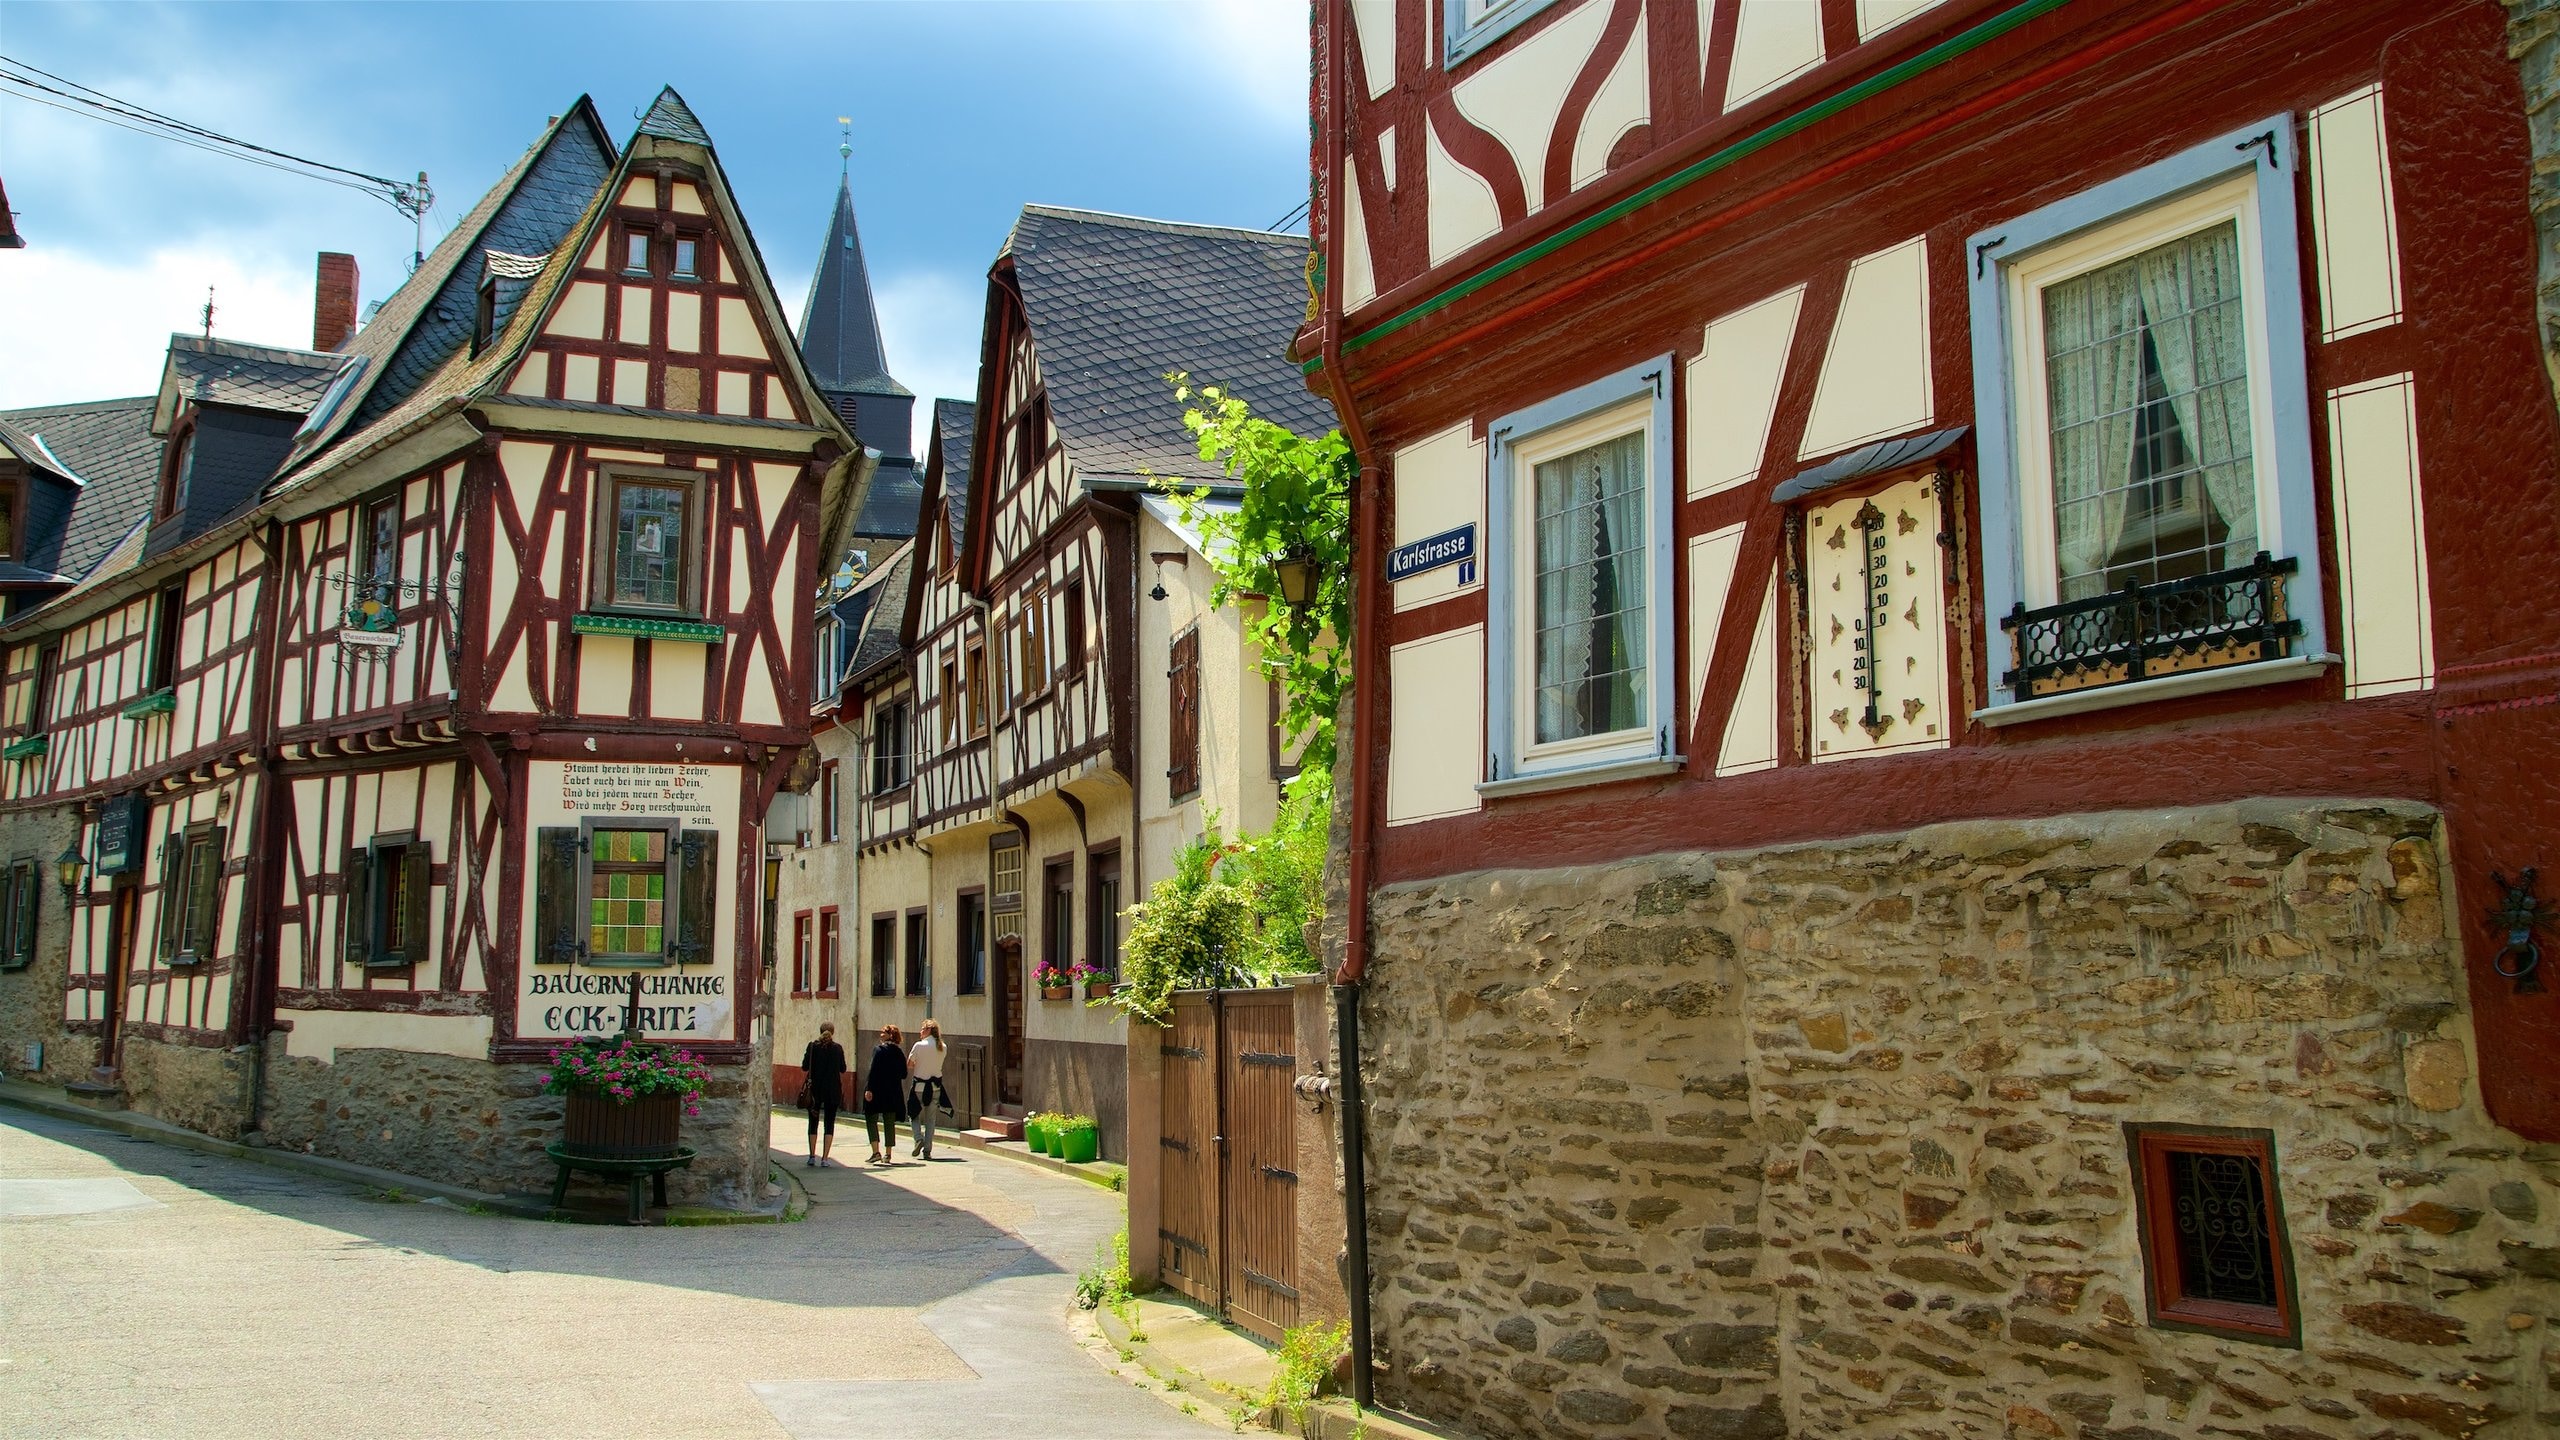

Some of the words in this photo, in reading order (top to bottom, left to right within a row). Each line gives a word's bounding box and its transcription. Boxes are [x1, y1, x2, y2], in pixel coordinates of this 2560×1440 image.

[1873, 536, 1886, 549] 40
[1393, 536, 1466, 573] Karlstrasse
[1874, 555, 1887, 568] 30
[1463, 562, 1470, 583] 1
[1875, 574, 1888, 588] 20
[1877, 593, 1888, 607] 10
[1855, 619, 1861, 631] 0
[1880, 613, 1887, 626] 0
[1854, 638, 1865, 651] 10
[1854, 657, 1865, 670] 20
[1854, 676, 1866, 689] 30
[563, 763, 599, 773] Strömt
[602, 764, 630, 776] herbei
[633, 765, 646, 776] ihr
[648, 765, 674, 775] lieben
[594, 777, 614, 787] euch
[618, 776, 631, 786] bei
[634, 778, 651, 787] mir
[655, 779, 669, 787] am
[563, 788, 583, 798] Und
[586, 788, 600, 798] bei
[602, 788, 629, 800] jedem
[633, 791, 658, 799] neuen
[563, 800, 590, 810] Wird
[593, 801, 617, 812] mehr
[620, 801, 646, 813] Sorg
[649, 801, 712, 813] verschwunden
[691, 816, 715, 825] sein.
